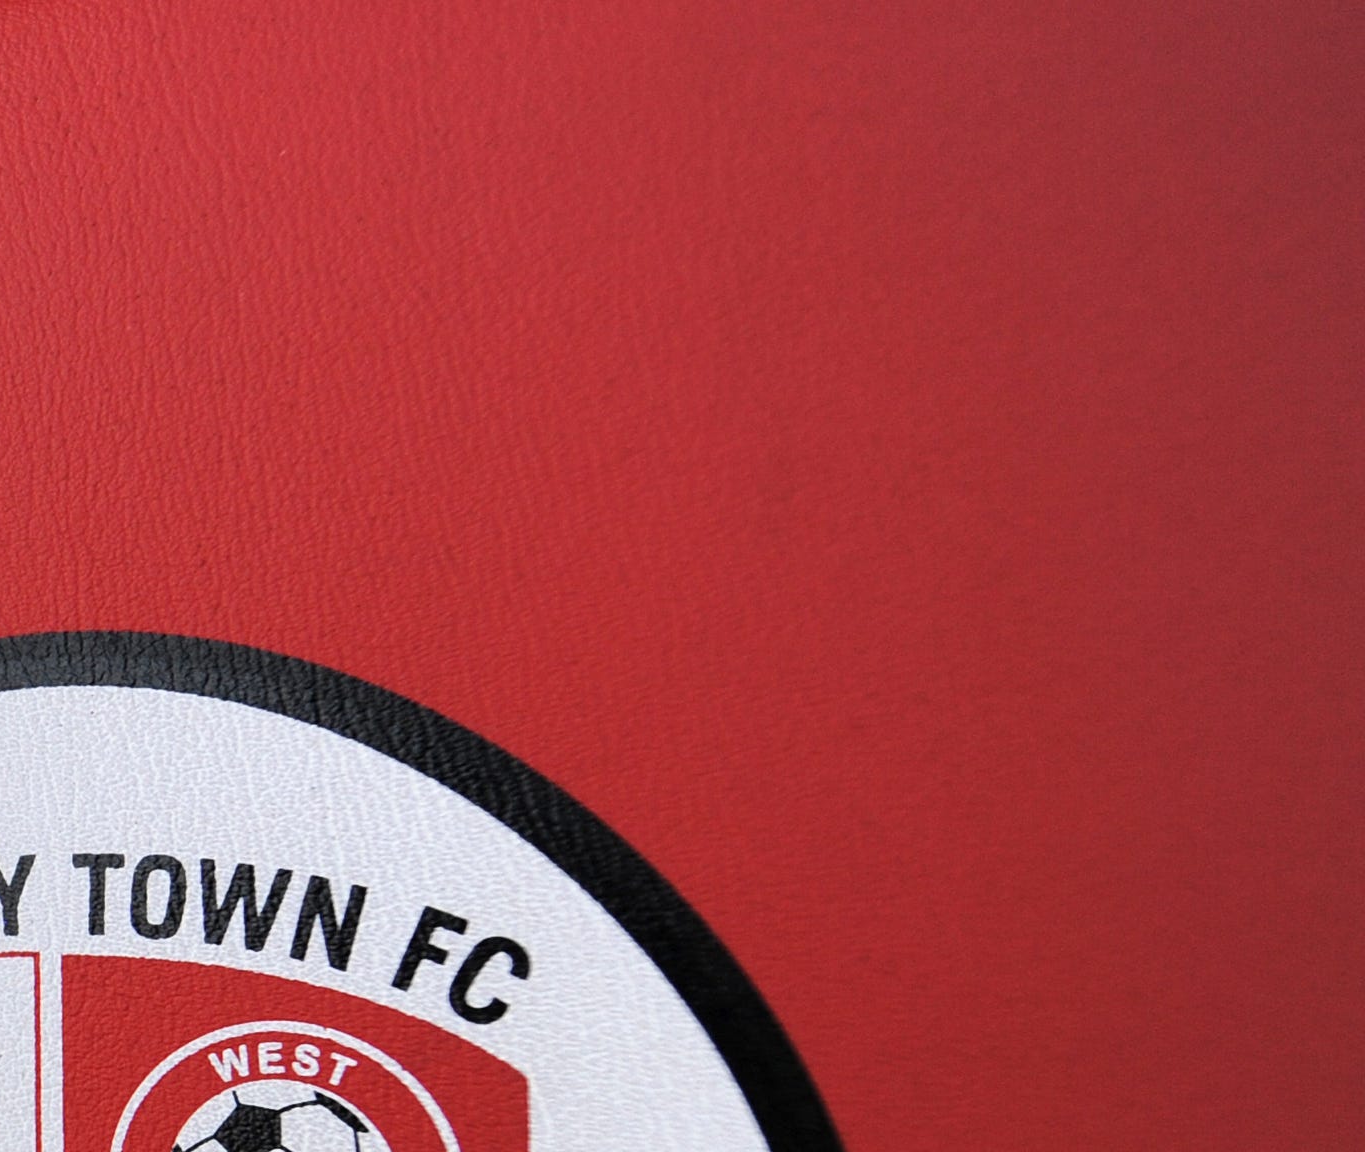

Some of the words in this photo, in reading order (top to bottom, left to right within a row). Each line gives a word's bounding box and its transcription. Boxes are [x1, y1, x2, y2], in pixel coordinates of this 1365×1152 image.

[72, 852, 367, 972] TOWN
[391, 905, 531, 1026] FC
[208, 1041, 357, 1084] WEST
